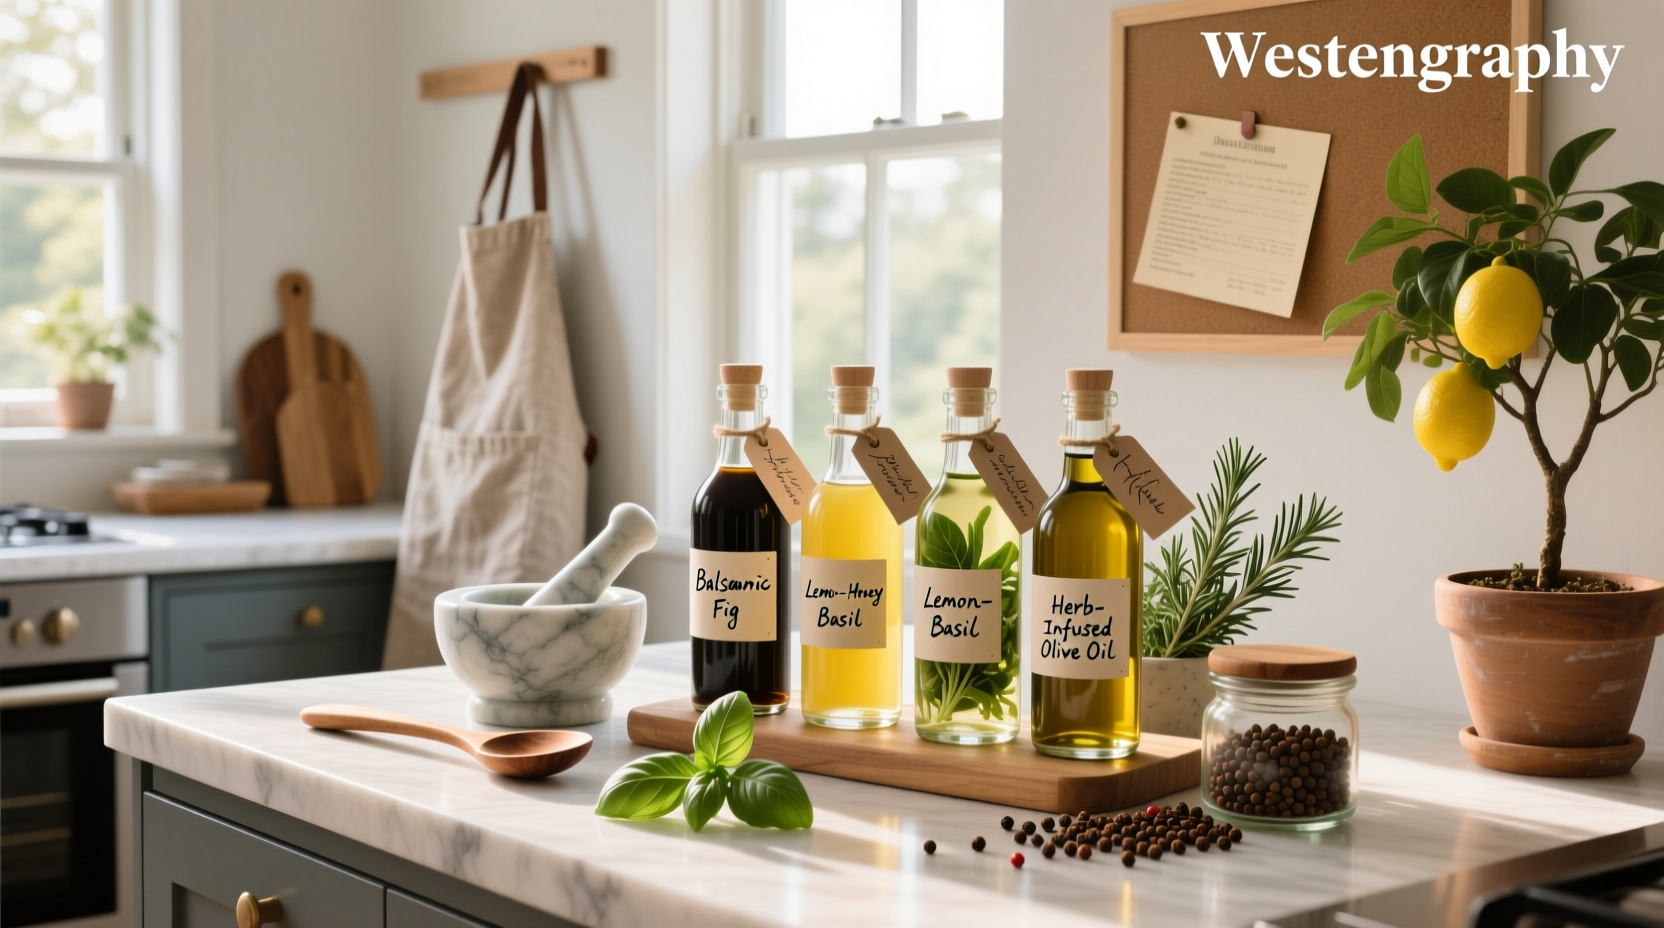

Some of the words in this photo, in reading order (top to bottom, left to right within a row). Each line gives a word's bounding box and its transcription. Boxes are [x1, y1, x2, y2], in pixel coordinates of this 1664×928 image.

[923, 587, 993, 609] Lemon-
[1051, 594, 1104, 616] Herb-
[713, 598, 739, 630] Fig
[817, 606, 863, 628] Basil
[930, 616, 980, 638] Basil
[1043, 617, 1112, 642] Infused
[1040, 640, 1081, 660] Olive
[1086, 640, 1117, 660] Oil
